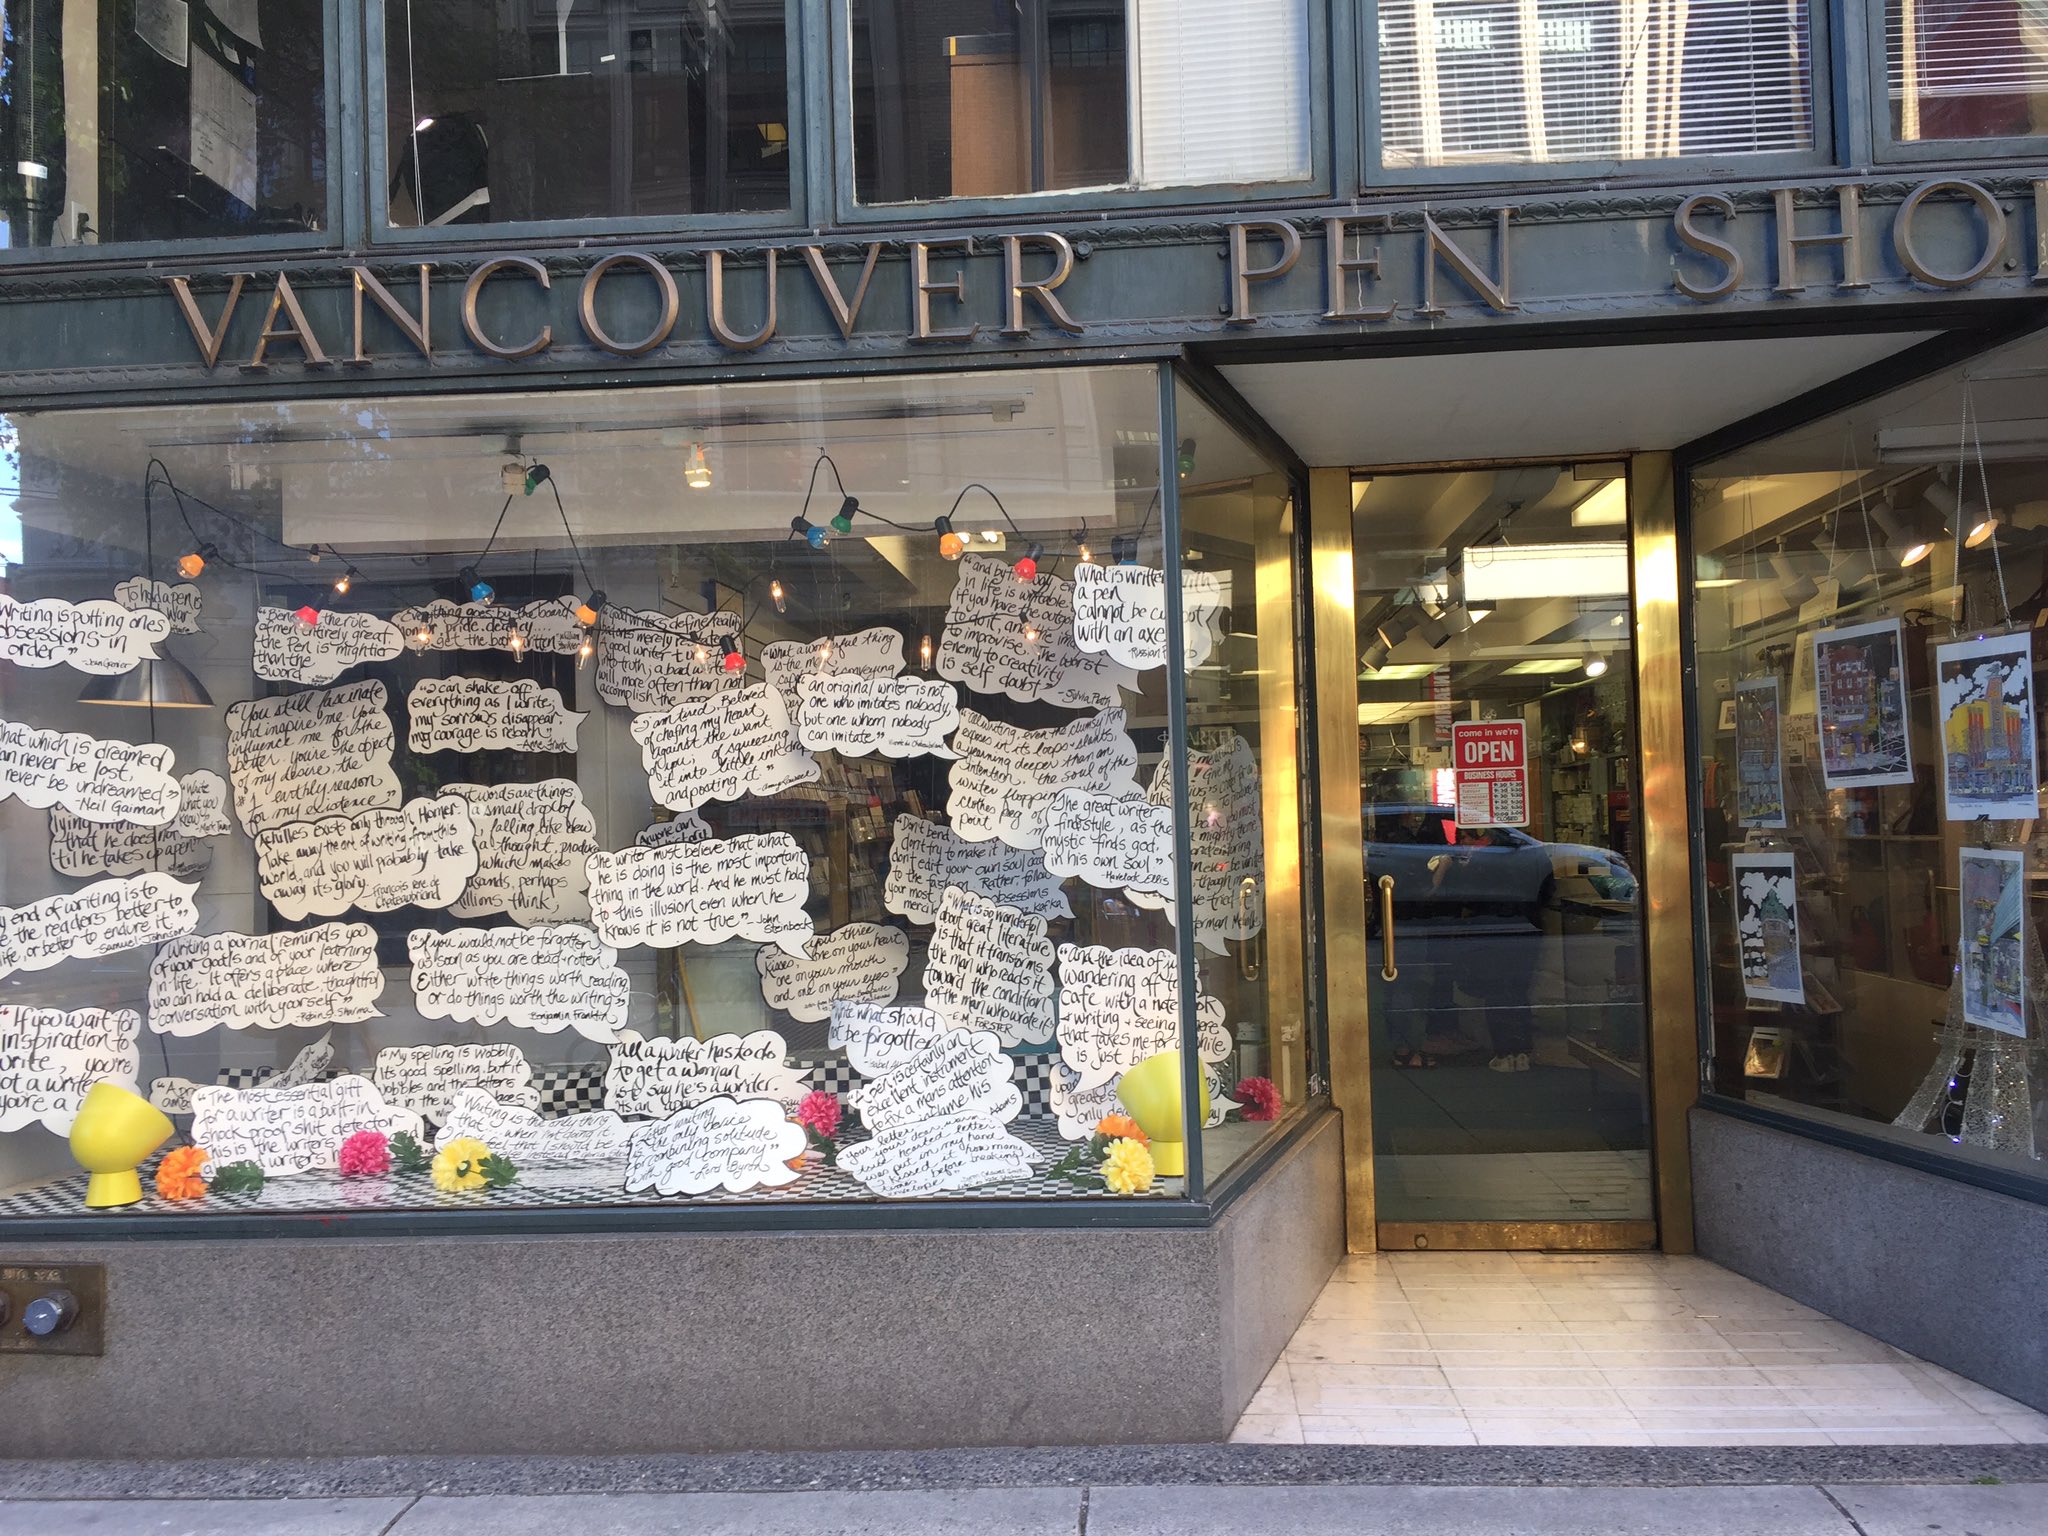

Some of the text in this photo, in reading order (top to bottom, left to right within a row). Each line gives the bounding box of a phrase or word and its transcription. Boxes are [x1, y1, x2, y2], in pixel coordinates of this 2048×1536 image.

[161, 179, 2048, 373] VANCOUVER PEN SHO
[1080, 565, 1107, 585] What
[72, 608, 124, 635] putting
[1078, 602, 1147, 623] cannot be
[636, 632, 672, 651] merely
[1114, 626, 1133, 642] an
[942, 640, 1064, 682] enemy to creativity
[647, 676, 720, 694] often than
[961, 660, 993, 688] self
[439, 680, 532, 700] can shake off
[828, 680, 950, 698] original writer not
[274, 681, 383, 720] still fascinate
[410, 695, 500, 718] everything as
[809, 696, 900, 711] one who imitates
[441, 711, 497, 726] sorrows
[723, 703, 765, 724] heart
[804, 711, 886, 728] but one whom
[733, 716, 771, 736] want
[807, 728, 828, 742] can
[1459, 727, 1519, 738] come in we're
[411, 727, 482, 749] my courage
[29, 730, 168, 772] which is dreamed
[1464, 741, 1515, 763] OPEN
[20, 752, 88, 774] never be
[1014, 755, 1059, 776] deeper
[5, 768, 68, 790] never be
[1464, 770, 1516, 779] BUSINESS HOURS
[474, 786, 515, 803] words
[111, 803, 166, 819] Gaiman
[1083, 800, 1160, 822] great writer
[313, 820, 346, 837] exists
[489, 818, 534, 847] falling
[1130, 819, 1173, 838] as the
[654, 832, 790, 860] must believe that what
[958, 847, 986, 859] make
[1044, 832, 1126, 855] mystic finds
[598, 850, 807, 885] he the most important
[974, 855, 1025, 876] own soul
[1067, 849, 1118, 870] his own
[518, 870, 569, 898] perhaps
[591, 888, 623, 906] thing
[707, 877, 730, 892] And
[733, 873, 746, 887] he
[751, 870, 781, 884] must
[10, 881, 158, 924] end of writing to
[595, 909, 609, 922] to
[613, 904, 643, 922] this
[650, 897, 698, 917] illusion
[700, 897, 726, 911] even
[731, 891, 768, 908] when
[14, 893, 183, 943] the readers better to
[646, 915, 699, 936] it not
[42, 919, 150, 957] better to endure
[167, 924, 368, 960] Writing journal reminds you
[459, 931, 535, 949] would not be
[998, 923, 1051, 957] literature
[289, 941, 374, 965] your learning
[438, 952, 528, 969] soon as are
[986, 944, 1044, 974] transforms
[837, 954, 886, 975] mouth
[416, 969, 583, 993] Either write things worth
[925, 963, 1050, 1013] toward the condition
[1064, 968, 1162, 997] wandering off
[428, 988, 569, 1006] or do worth the
[65, 1009, 140, 1036] wait for
[975, 1016, 1017, 1038] FORSTER
[1, 1030, 129, 1053] inspiration to
[644, 1040, 776, 1062] a writer has do
[845, 1023, 941, 1057] be forgotten
[410, 1046, 454, 1065] spelling
[399, 1062, 427, 1081] good
[667, 1061, 740, 1079] a woman
[948, 1053, 1003, 1091] attention
[866, 1083, 922, 1117] excellent
[249, 1114, 404, 1140] proof shit detector
